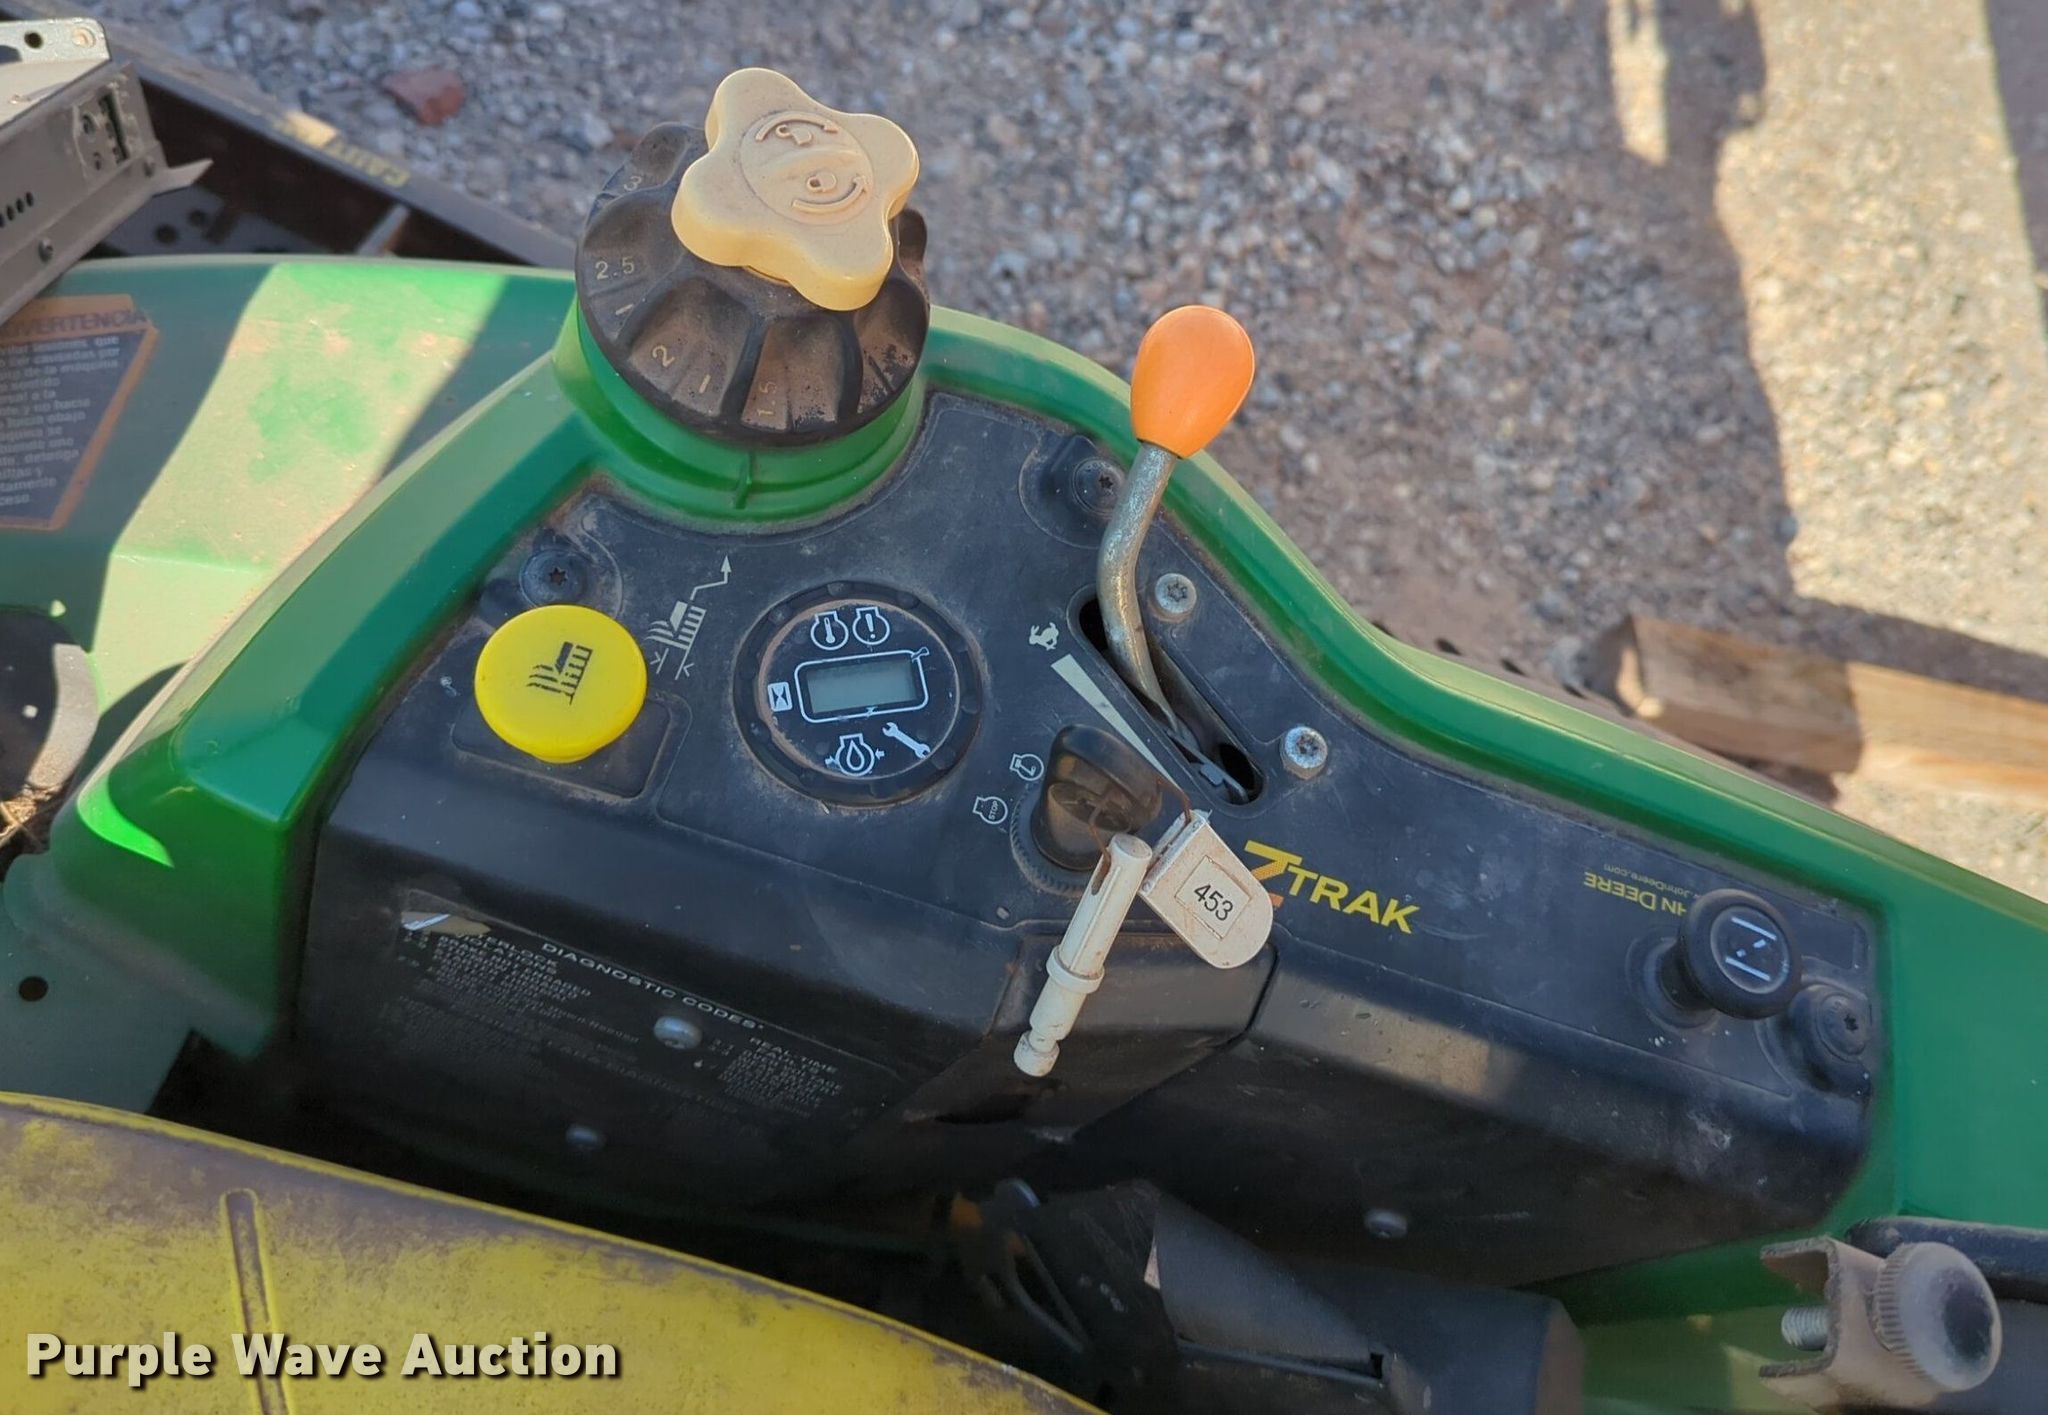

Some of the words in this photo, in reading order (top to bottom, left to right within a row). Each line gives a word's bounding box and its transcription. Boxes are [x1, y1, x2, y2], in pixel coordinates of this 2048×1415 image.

[623, 174, 643, 192] 3
[595, 256, 635, 280] 2.5
[652, 345, 675, 367] 2
[987, 800, 999, 821] STOP
[1193, 883, 1234, 922] 453
[541, 942, 677, 999] DIAGNOSTIC
